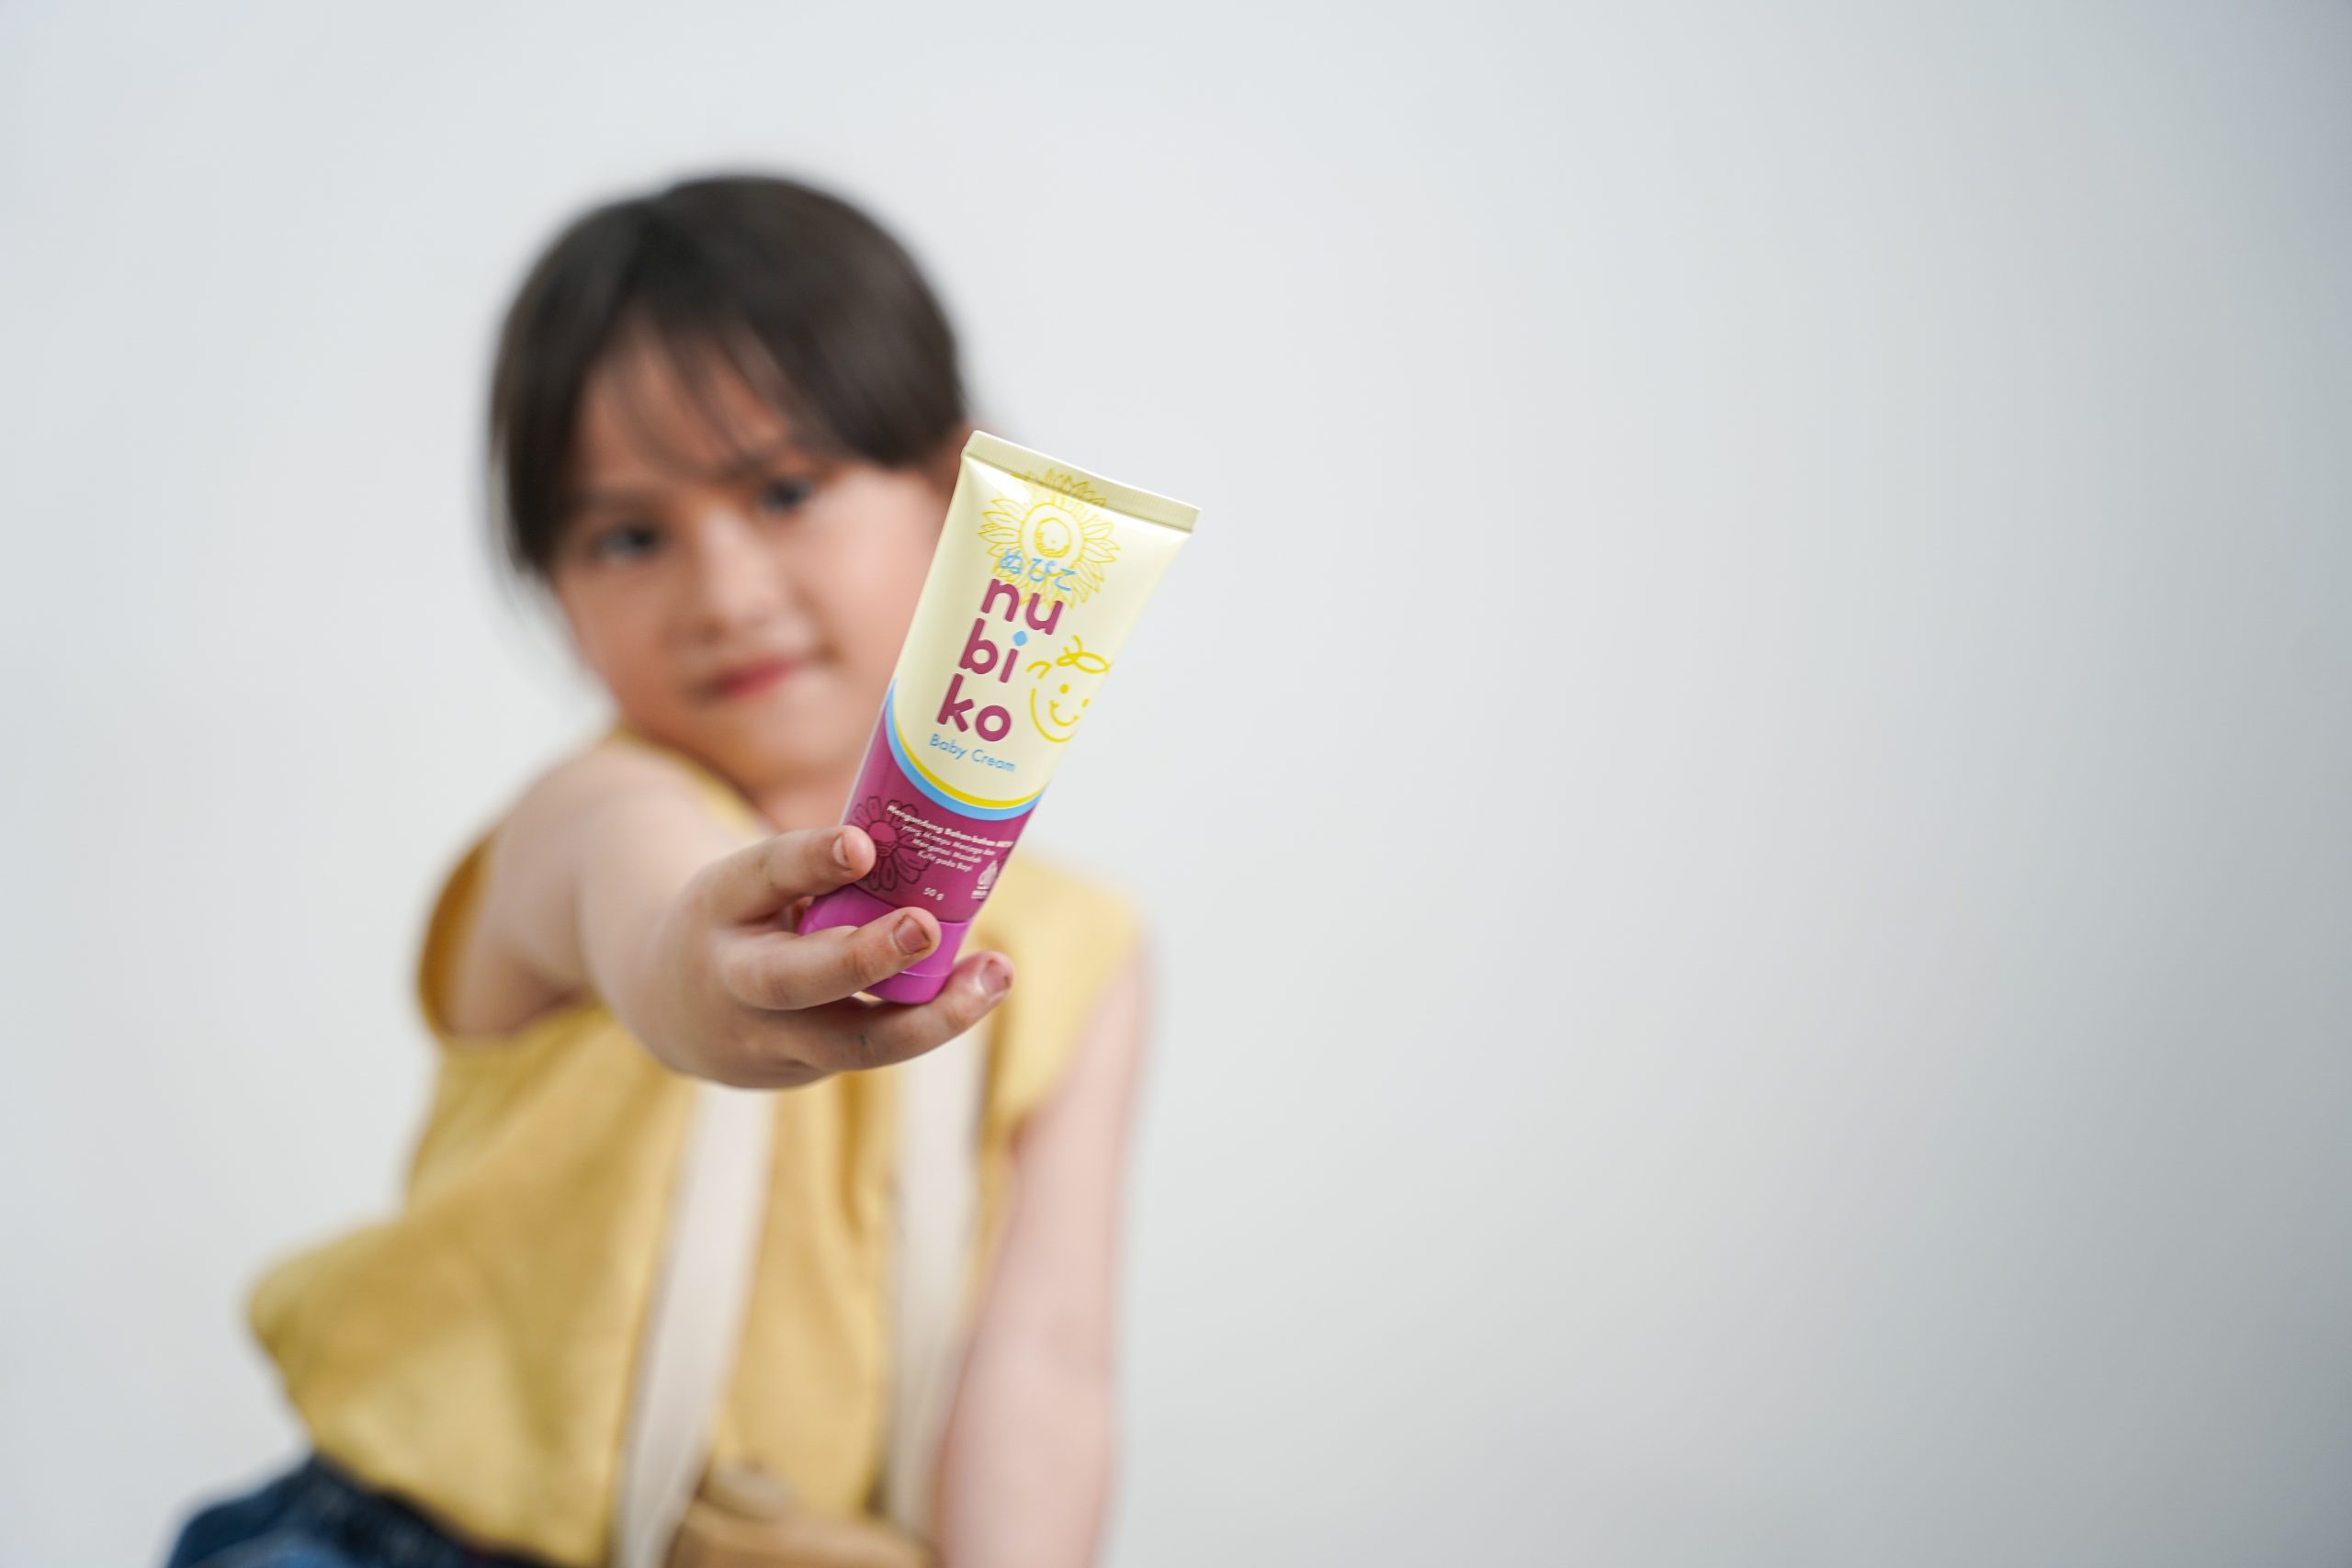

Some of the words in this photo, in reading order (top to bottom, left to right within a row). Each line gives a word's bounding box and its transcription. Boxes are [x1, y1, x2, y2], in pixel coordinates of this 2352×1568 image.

[980, 578, 1064, 636] nu
[958, 617, 1028, 683] bi
[936, 672, 1012, 742] ko
[929, 733, 967, 760] Baby
[971, 748, 1016, 773] Cream
[923, 887, 935, 897] 50
